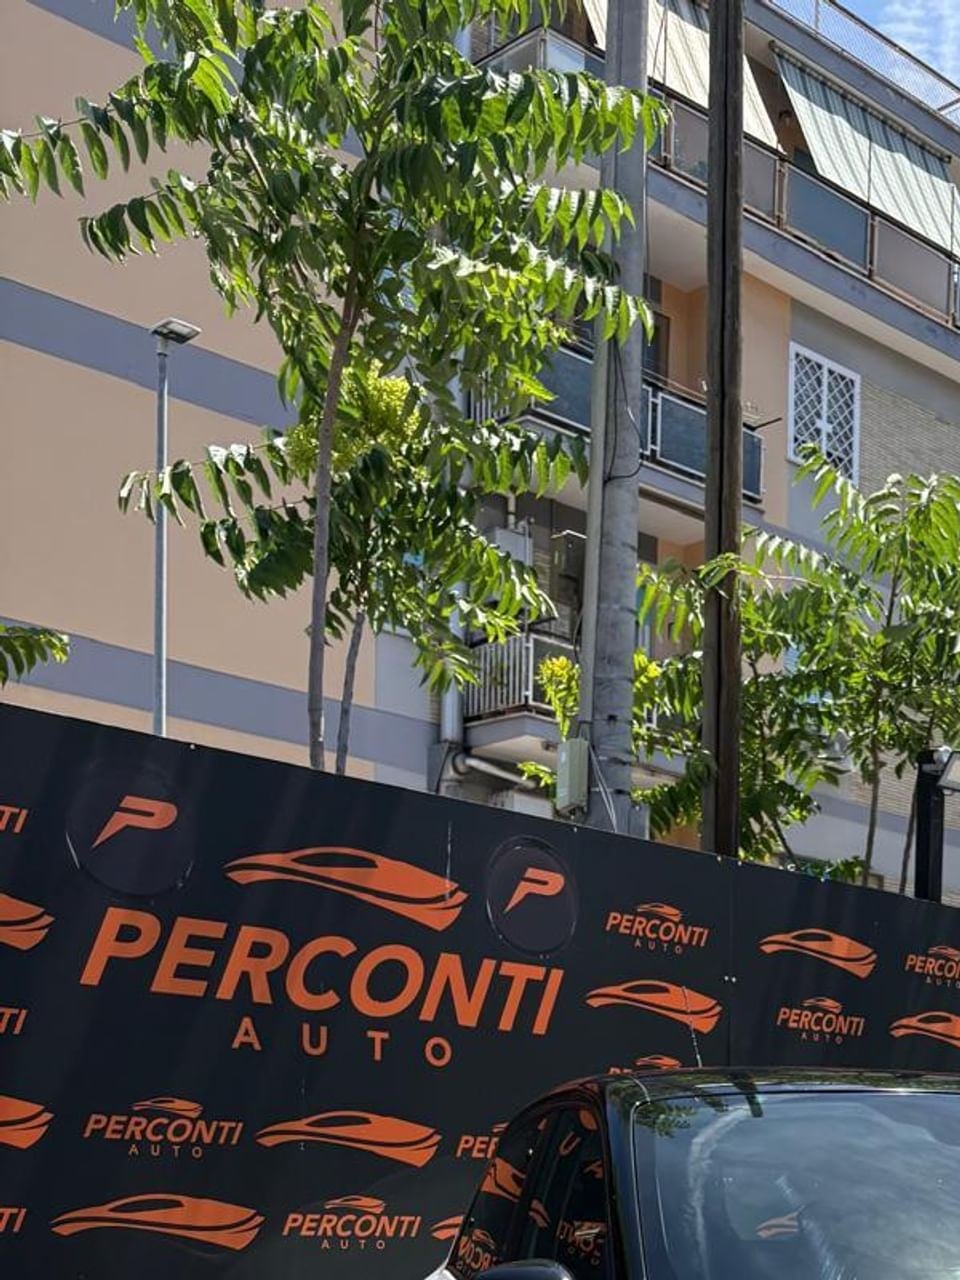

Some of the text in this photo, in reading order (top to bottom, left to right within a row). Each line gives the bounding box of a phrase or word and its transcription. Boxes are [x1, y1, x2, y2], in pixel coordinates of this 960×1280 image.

[605, 912, 709, 947] PERCONTI
[634, 939, 683, 954] AUTO
[80, 906, 564, 1036] PERCONTI
[777, 1008, 864, 1036] PERCONTI
[232, 1016, 452, 1067] AUTO
[801, 1032, 843, 1045] AUTO
[84, 1113, 243, 1145] PERCONTI
[128, 1144, 203, 1159] AUTO
[282, 1214, 421, 1238] PERCONTI
[320, 1239, 386, 1250] AUTO
